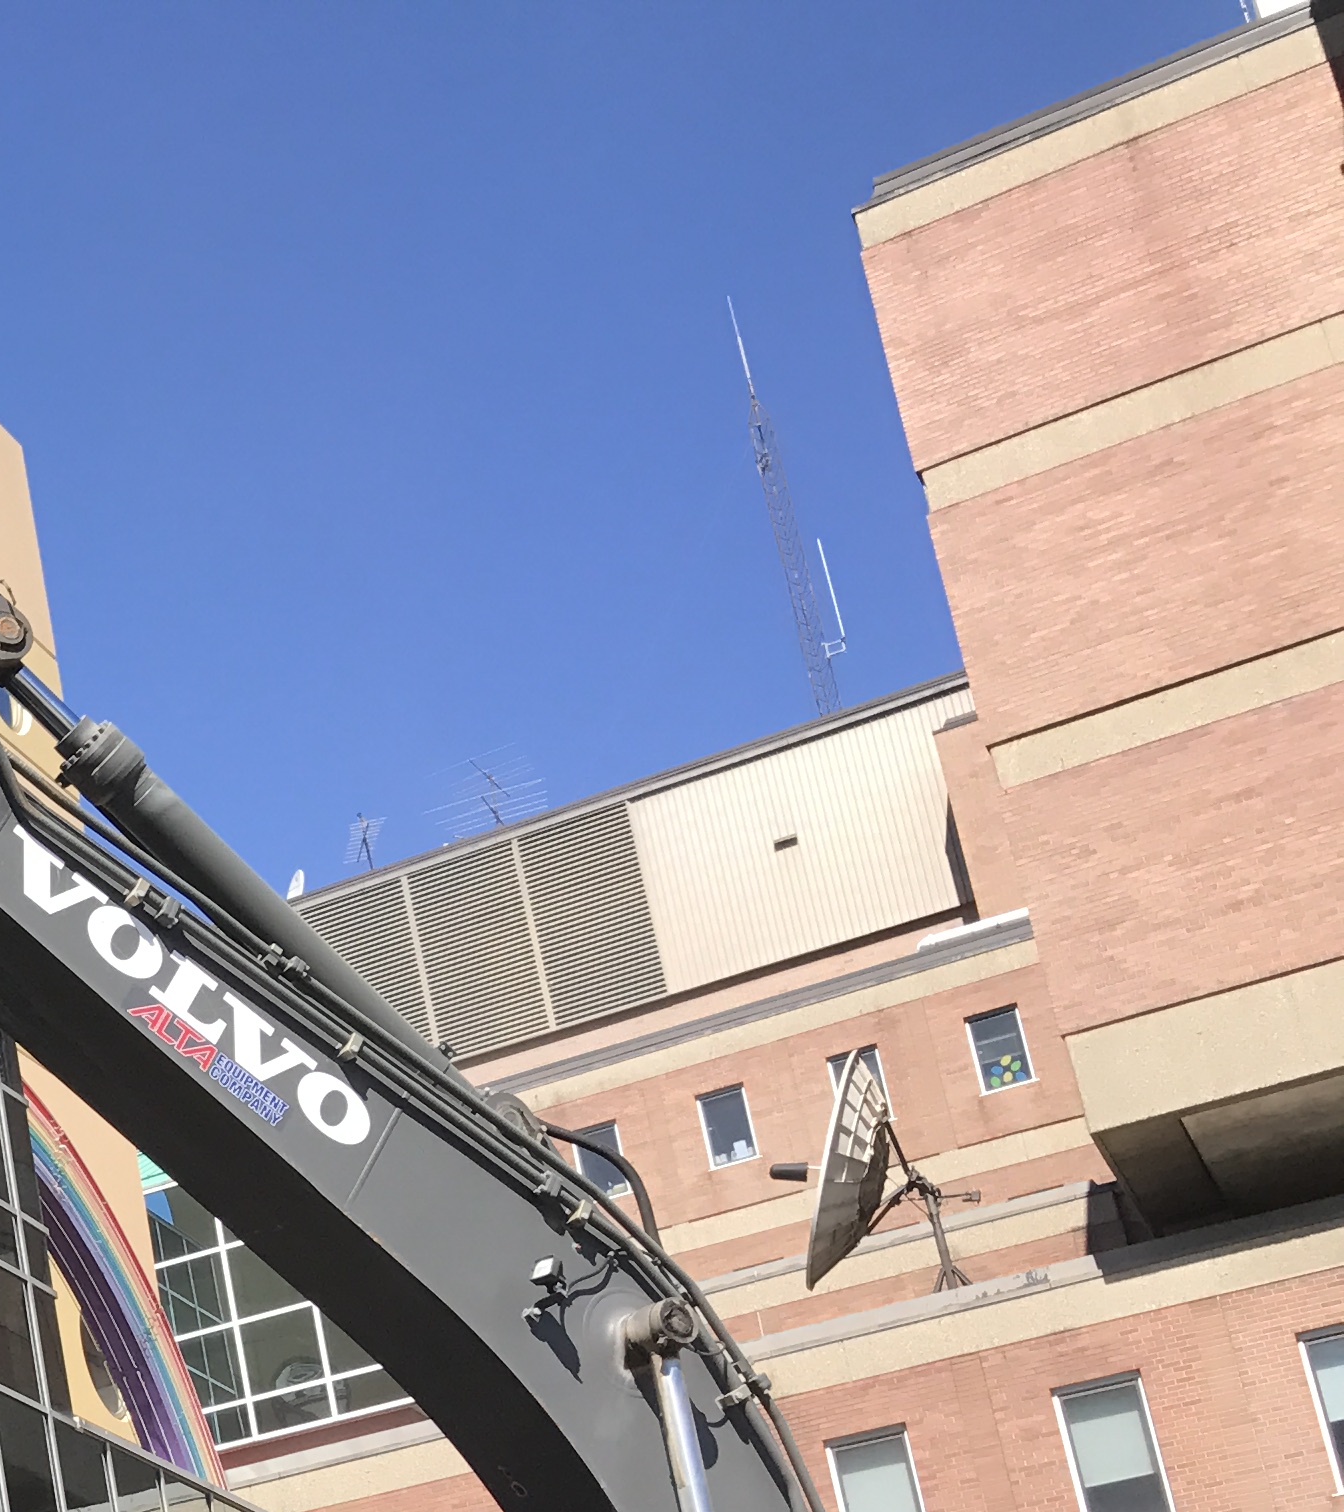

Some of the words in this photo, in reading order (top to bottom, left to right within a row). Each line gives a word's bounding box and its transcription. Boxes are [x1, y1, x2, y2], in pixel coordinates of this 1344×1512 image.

[14, 825, 371, 1145] VOLVO
[127, 1004, 218, 1072] ALTA
[209, 1065, 283, 1126] COMPANY
[215, 1052, 290, 1114] EQUIPMENT
